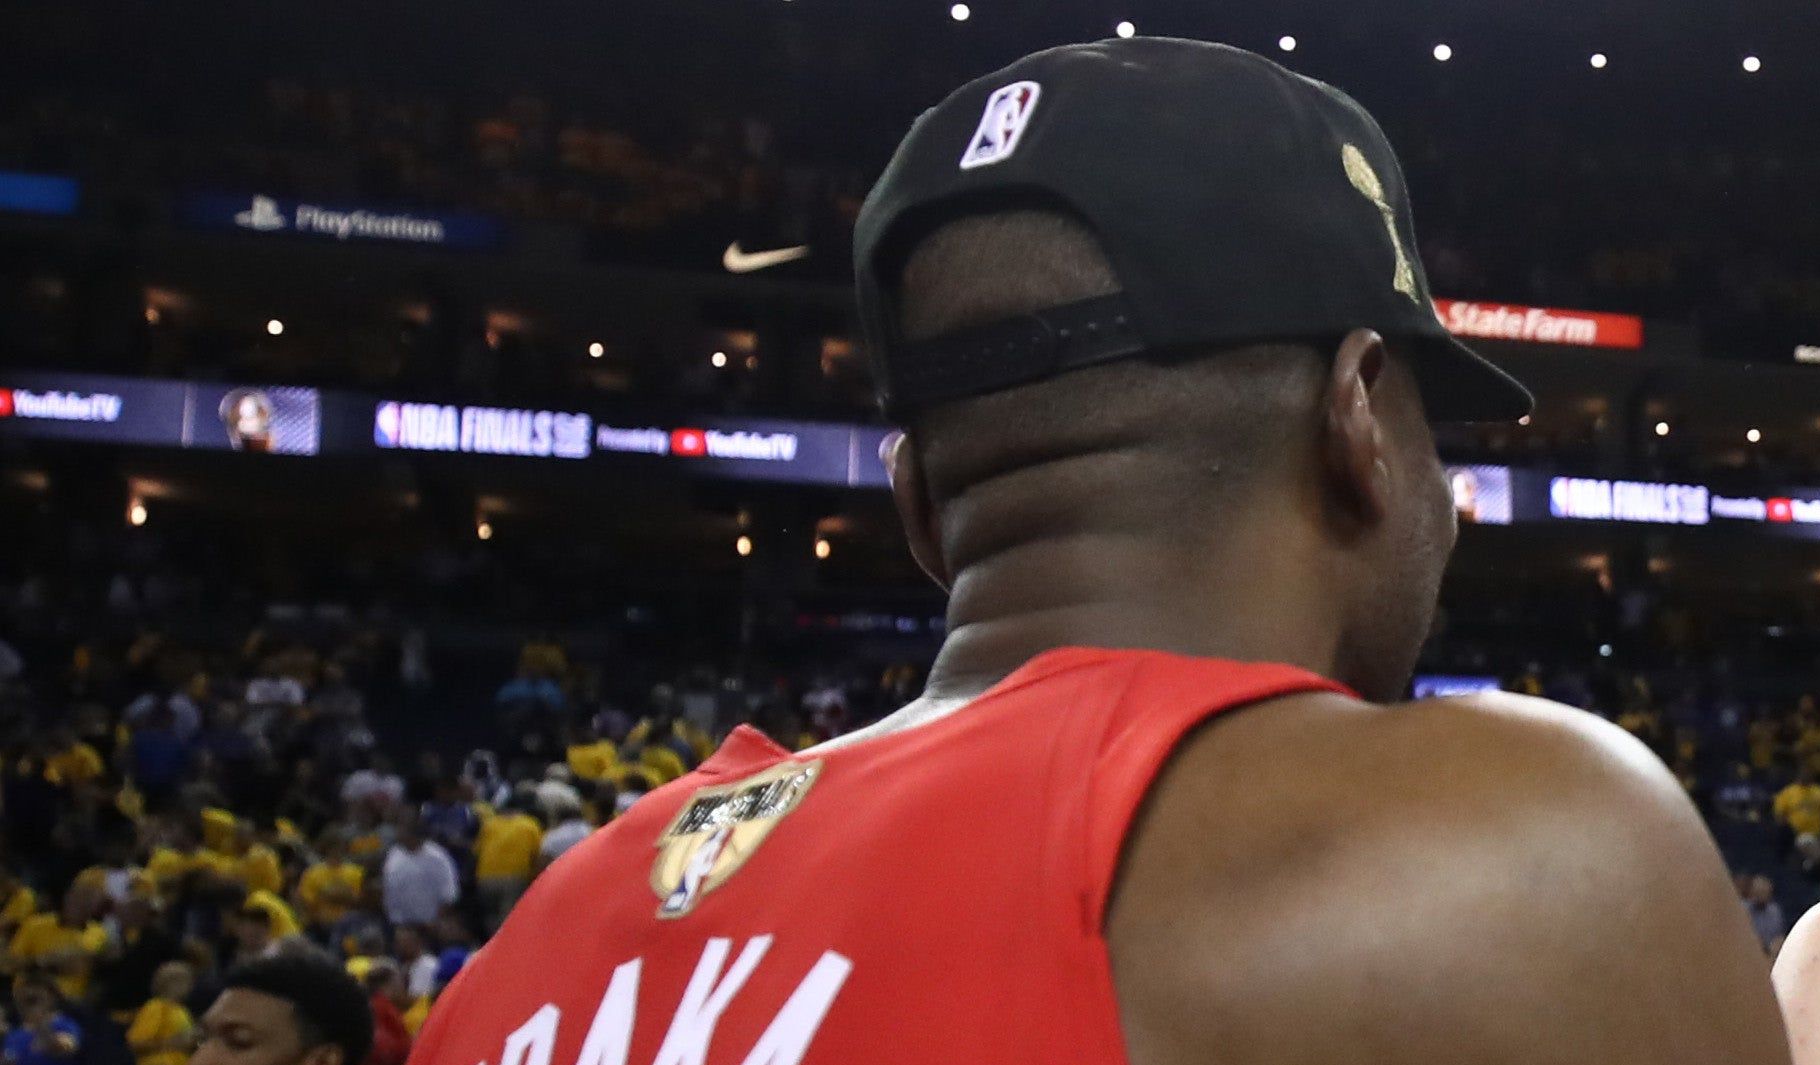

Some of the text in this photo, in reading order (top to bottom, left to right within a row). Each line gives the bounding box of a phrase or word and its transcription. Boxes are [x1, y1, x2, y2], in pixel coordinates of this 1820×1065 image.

[296, 204, 446, 242] PlayStation
[399, 402, 458, 451] NBA
[460, 406, 553, 457] FINALS
[1567, 478, 1612, 520] NBA
[1612, 481, 1679, 524] FINALS
